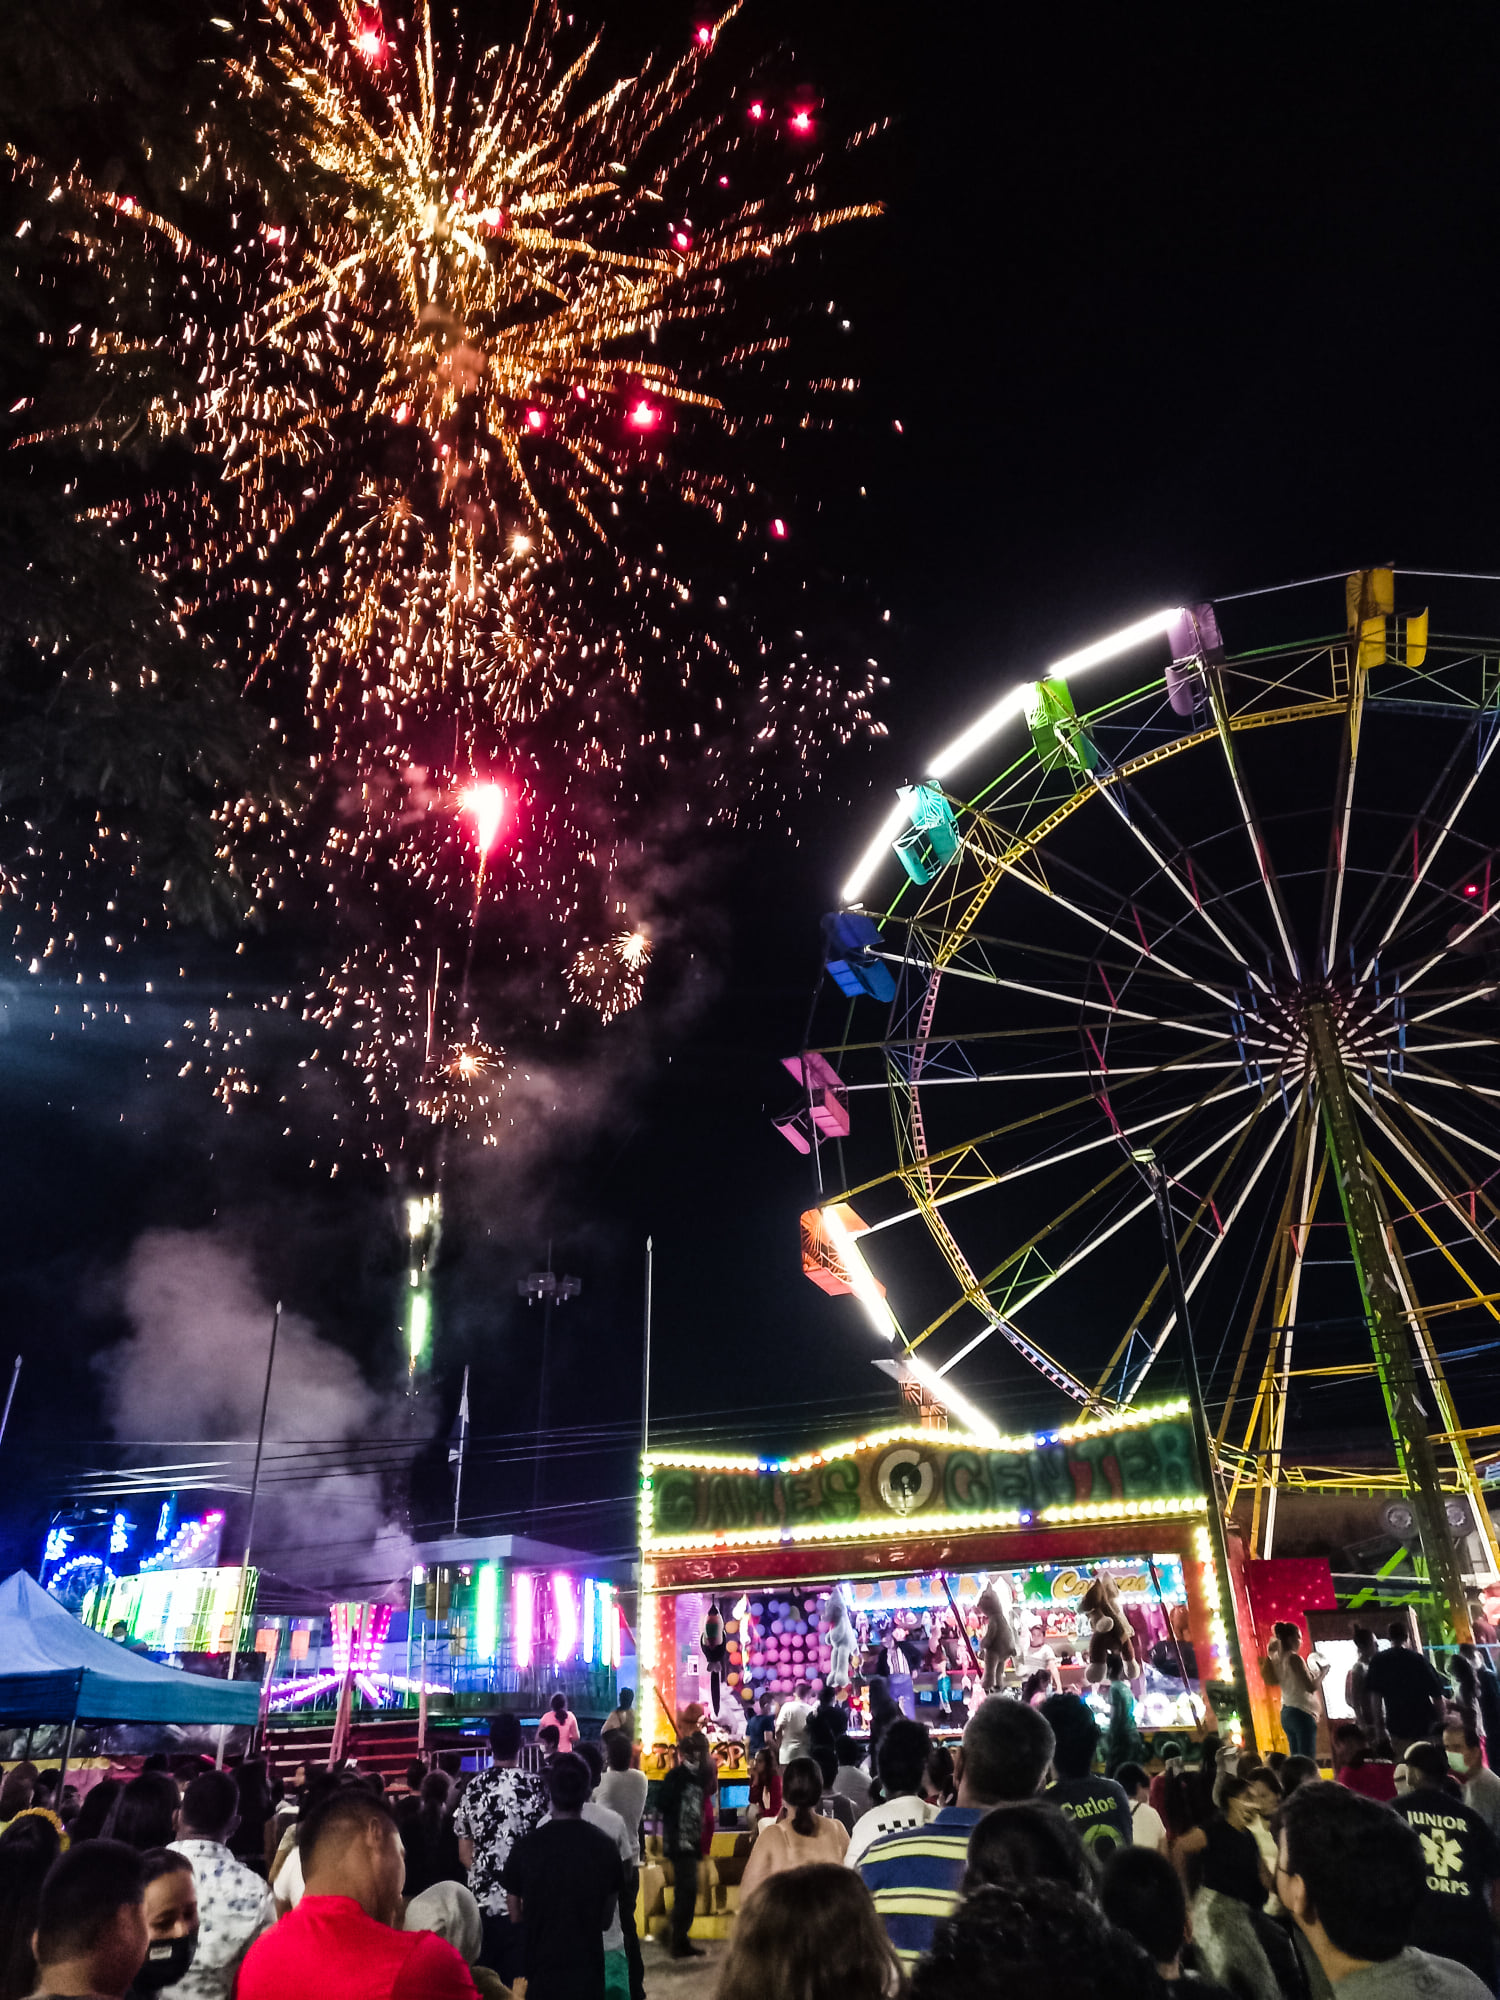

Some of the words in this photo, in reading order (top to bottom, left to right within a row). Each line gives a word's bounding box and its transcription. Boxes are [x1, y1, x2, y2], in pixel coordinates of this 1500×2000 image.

[658, 1460, 862, 1531] GAMES
[944, 1424, 1192, 1513] CENTER
[1060, 1796, 1118, 1821] Carlos
[1407, 1810, 1468, 1832] JUNIOR
[1425, 1875, 1471, 1896] ORPS
